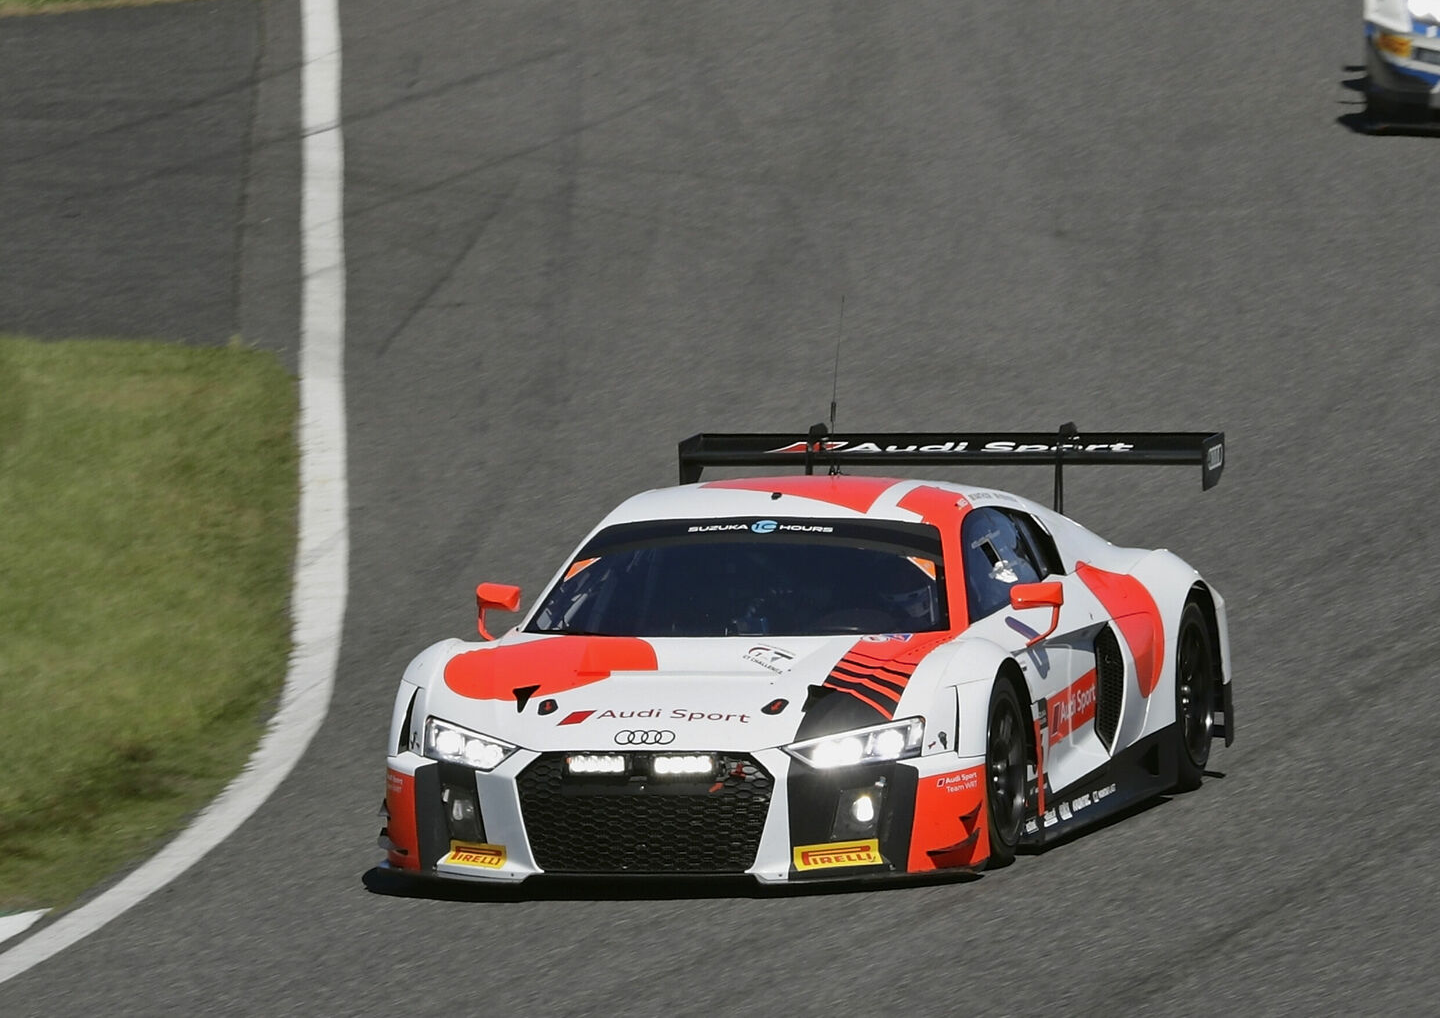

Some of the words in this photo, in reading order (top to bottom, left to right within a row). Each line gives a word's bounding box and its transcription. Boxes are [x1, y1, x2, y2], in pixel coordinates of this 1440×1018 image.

[842, 442, 968, 452] Audi
[981, 441, 1134, 452] Sport
[688, 524, 748, 533] SUZUKA
[779, 524, 834, 533] HOURS
[597, 709, 662, 720] Audi
[670, 709, 750, 724] Sport
[945, 776, 961, 785] Audi
[961, 772, 978, 782] Sport
[946, 784, 965, 793] Team
[451, 845, 503, 866] PIRELLI
[801, 845, 873, 866] PIRELLI
